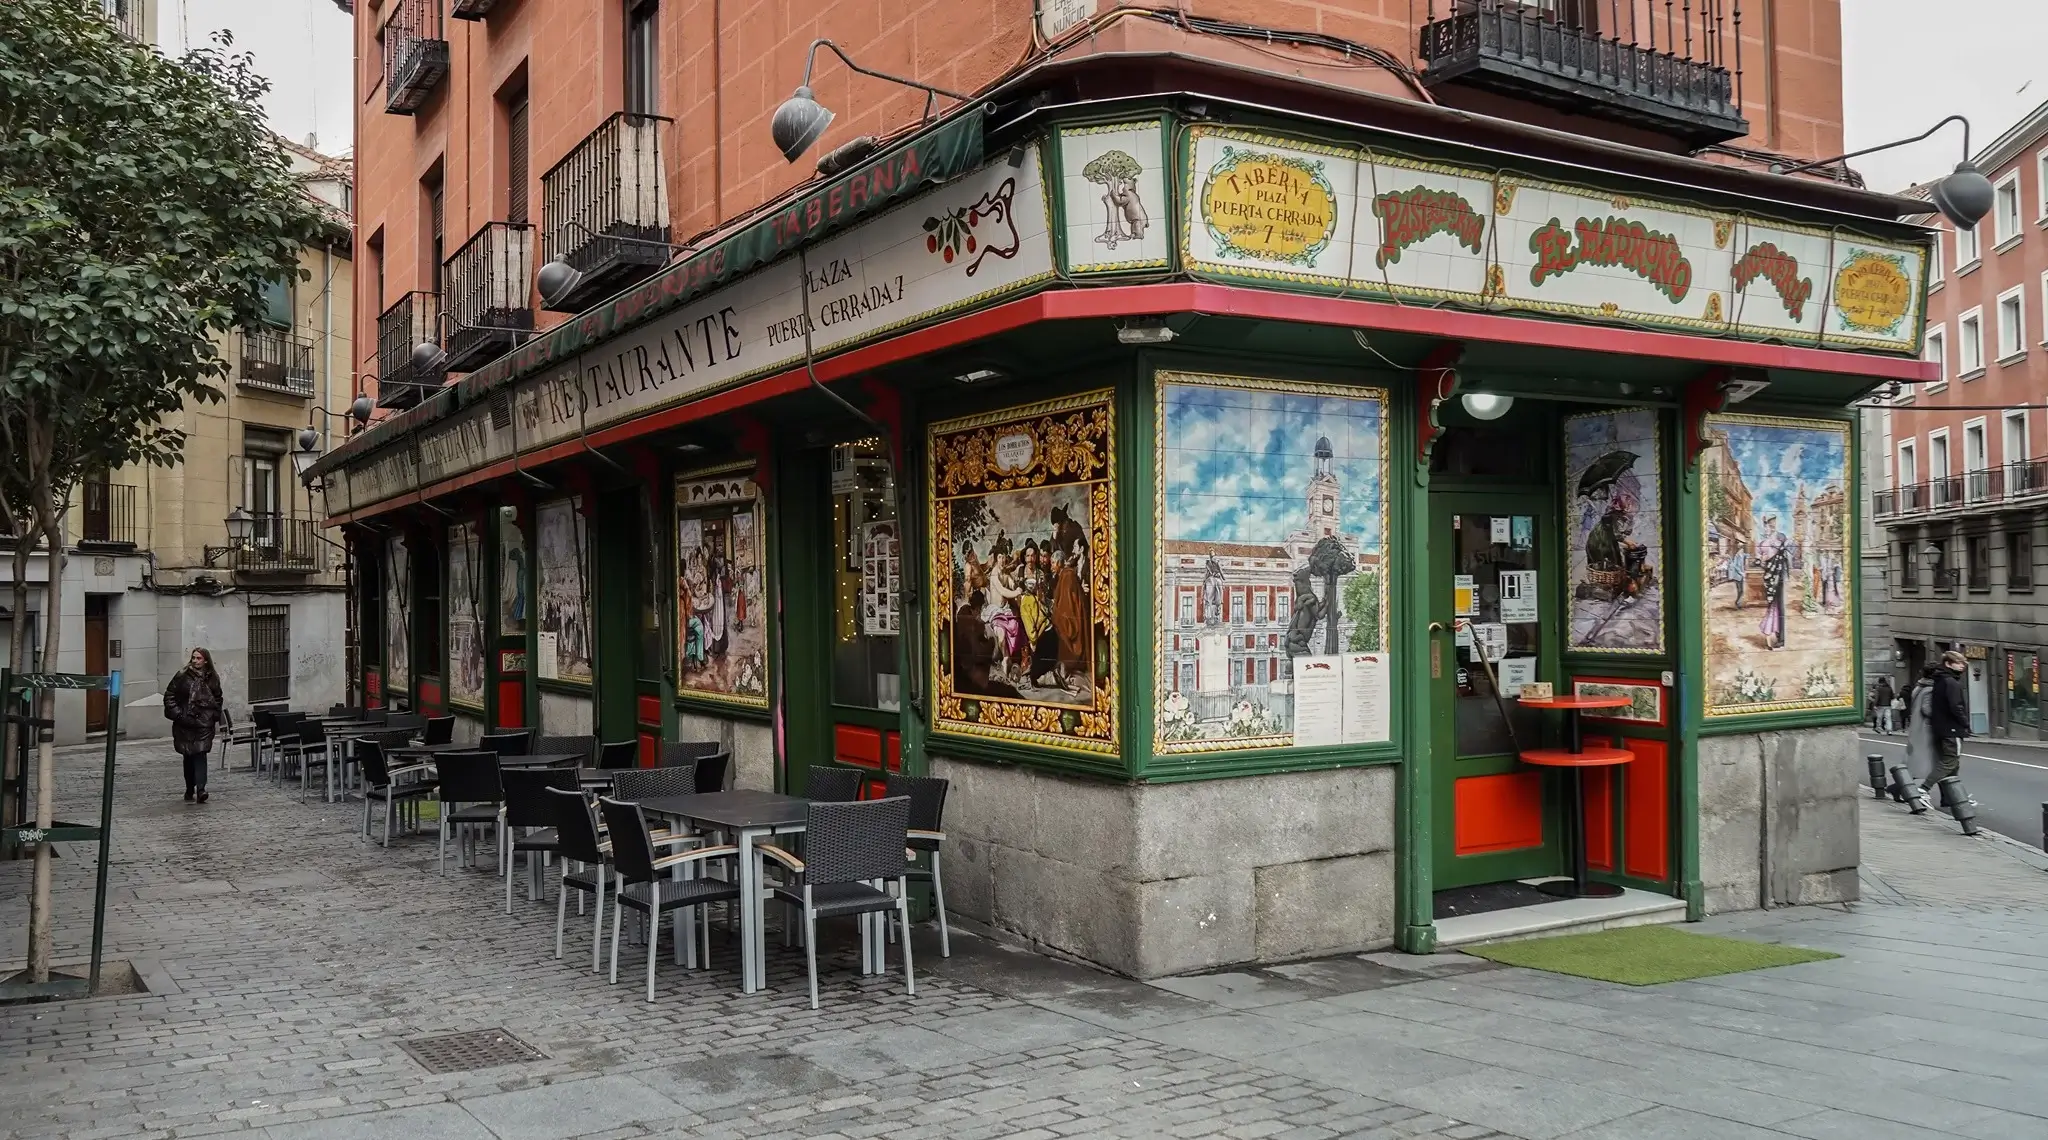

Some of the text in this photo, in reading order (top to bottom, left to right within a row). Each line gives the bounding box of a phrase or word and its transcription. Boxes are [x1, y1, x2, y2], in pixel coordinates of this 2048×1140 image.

[1053, 4, 1085, 36] NUNCIO
[772, 147, 922, 246] TABERNA
[1226, 167, 1309, 206] TABERNA
[1255, 190, 1287, 205] PLAZA
[1213, 199, 1324, 228] PUERTA CERRADA
[1262, 225, 1273, 244] 7
[1532, 219, 1576, 285] EL
[802, 257, 852, 295] PLAZA
[766, 275, 904, 347] PUERTA CERRADA 7
[547, 305, 742, 424] RESTAURANTE
[1501, 574, 1521, 599] H
